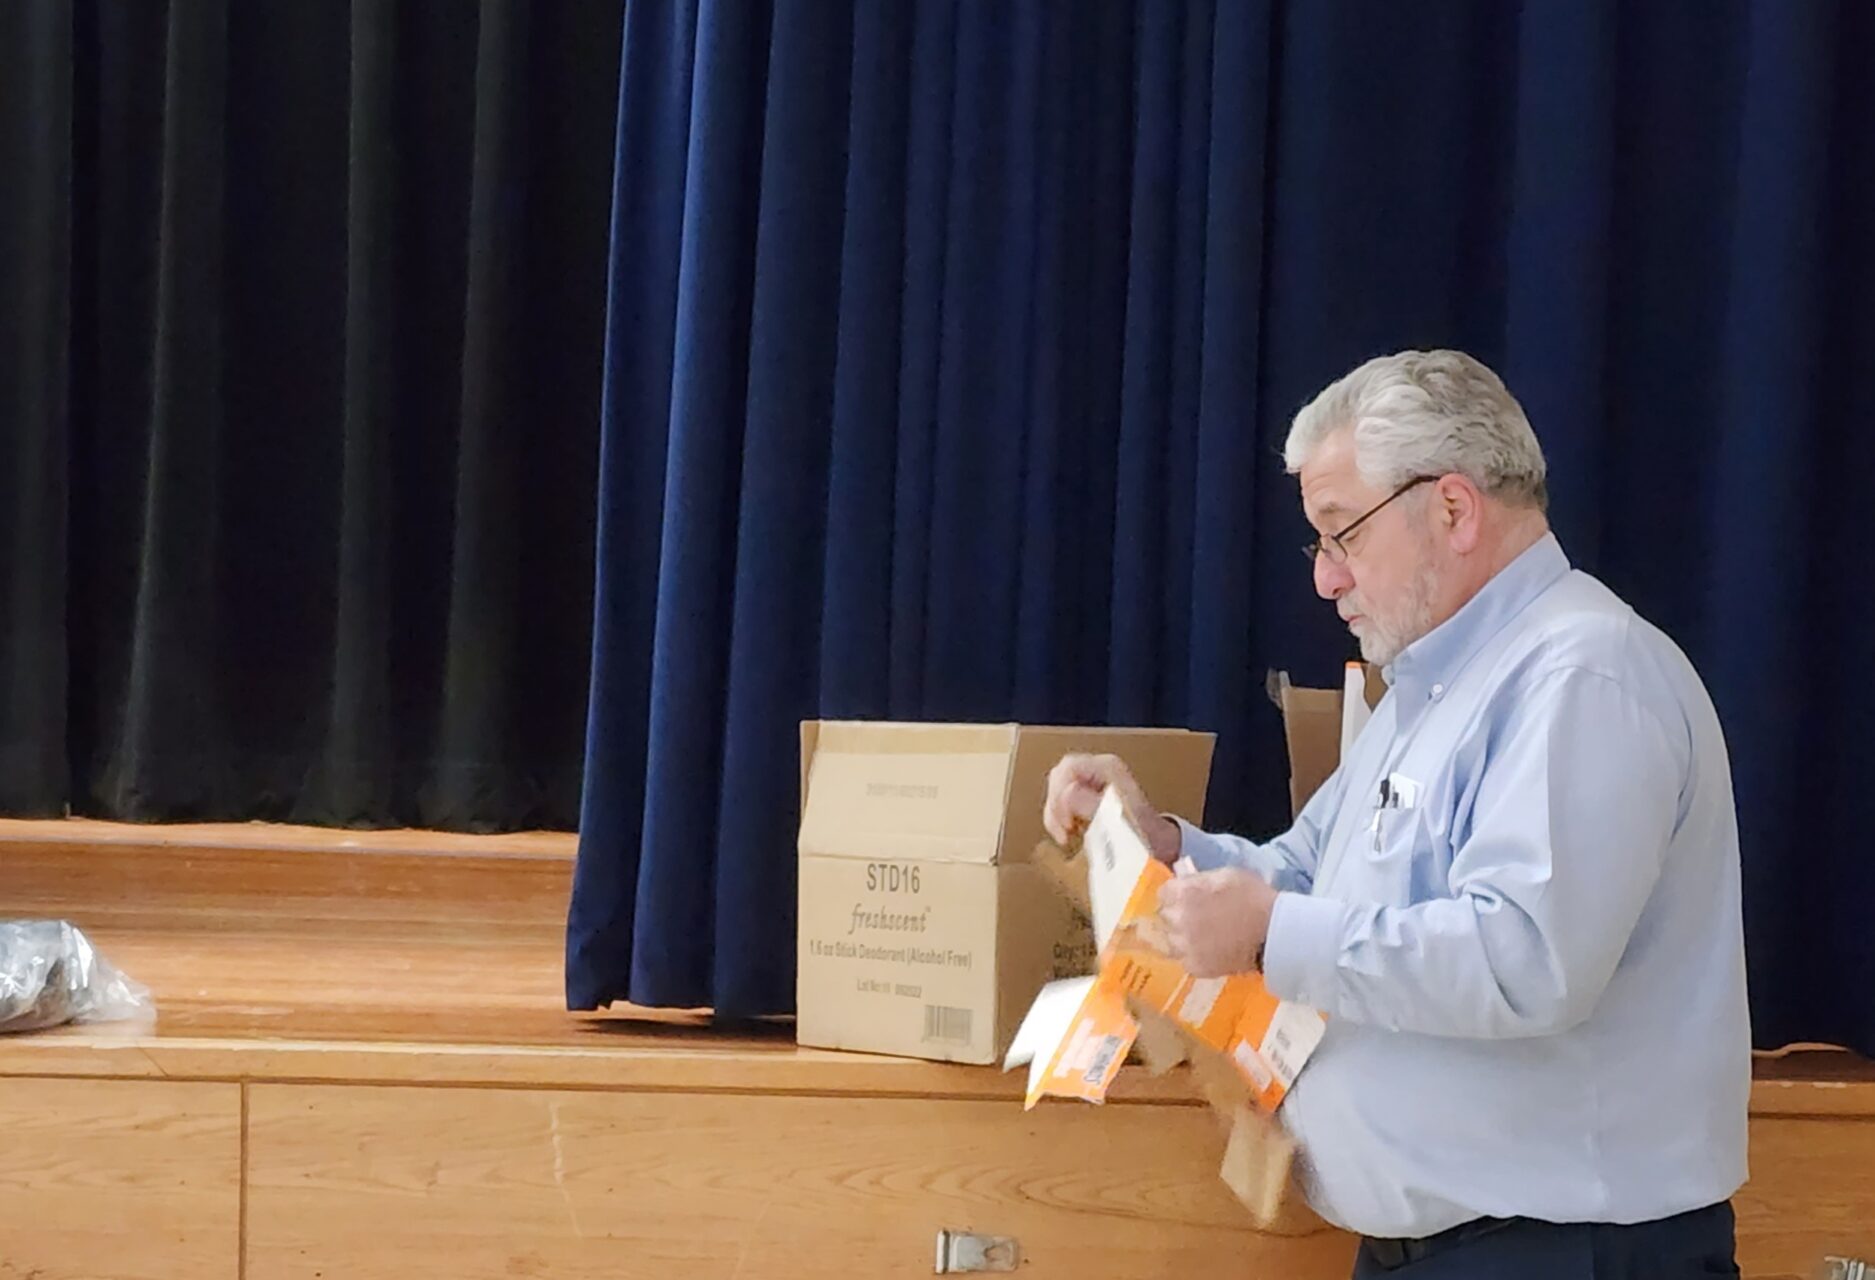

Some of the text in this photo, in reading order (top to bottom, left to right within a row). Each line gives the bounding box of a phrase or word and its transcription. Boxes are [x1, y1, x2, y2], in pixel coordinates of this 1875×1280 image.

[866, 863, 921, 894] STD16
[848, 903, 928, 935] freshscent
[858, 944, 905, 963] Deodorant
[906, 947, 946, 967] (Alcohol
[947, 950, 973, 970] Free)
